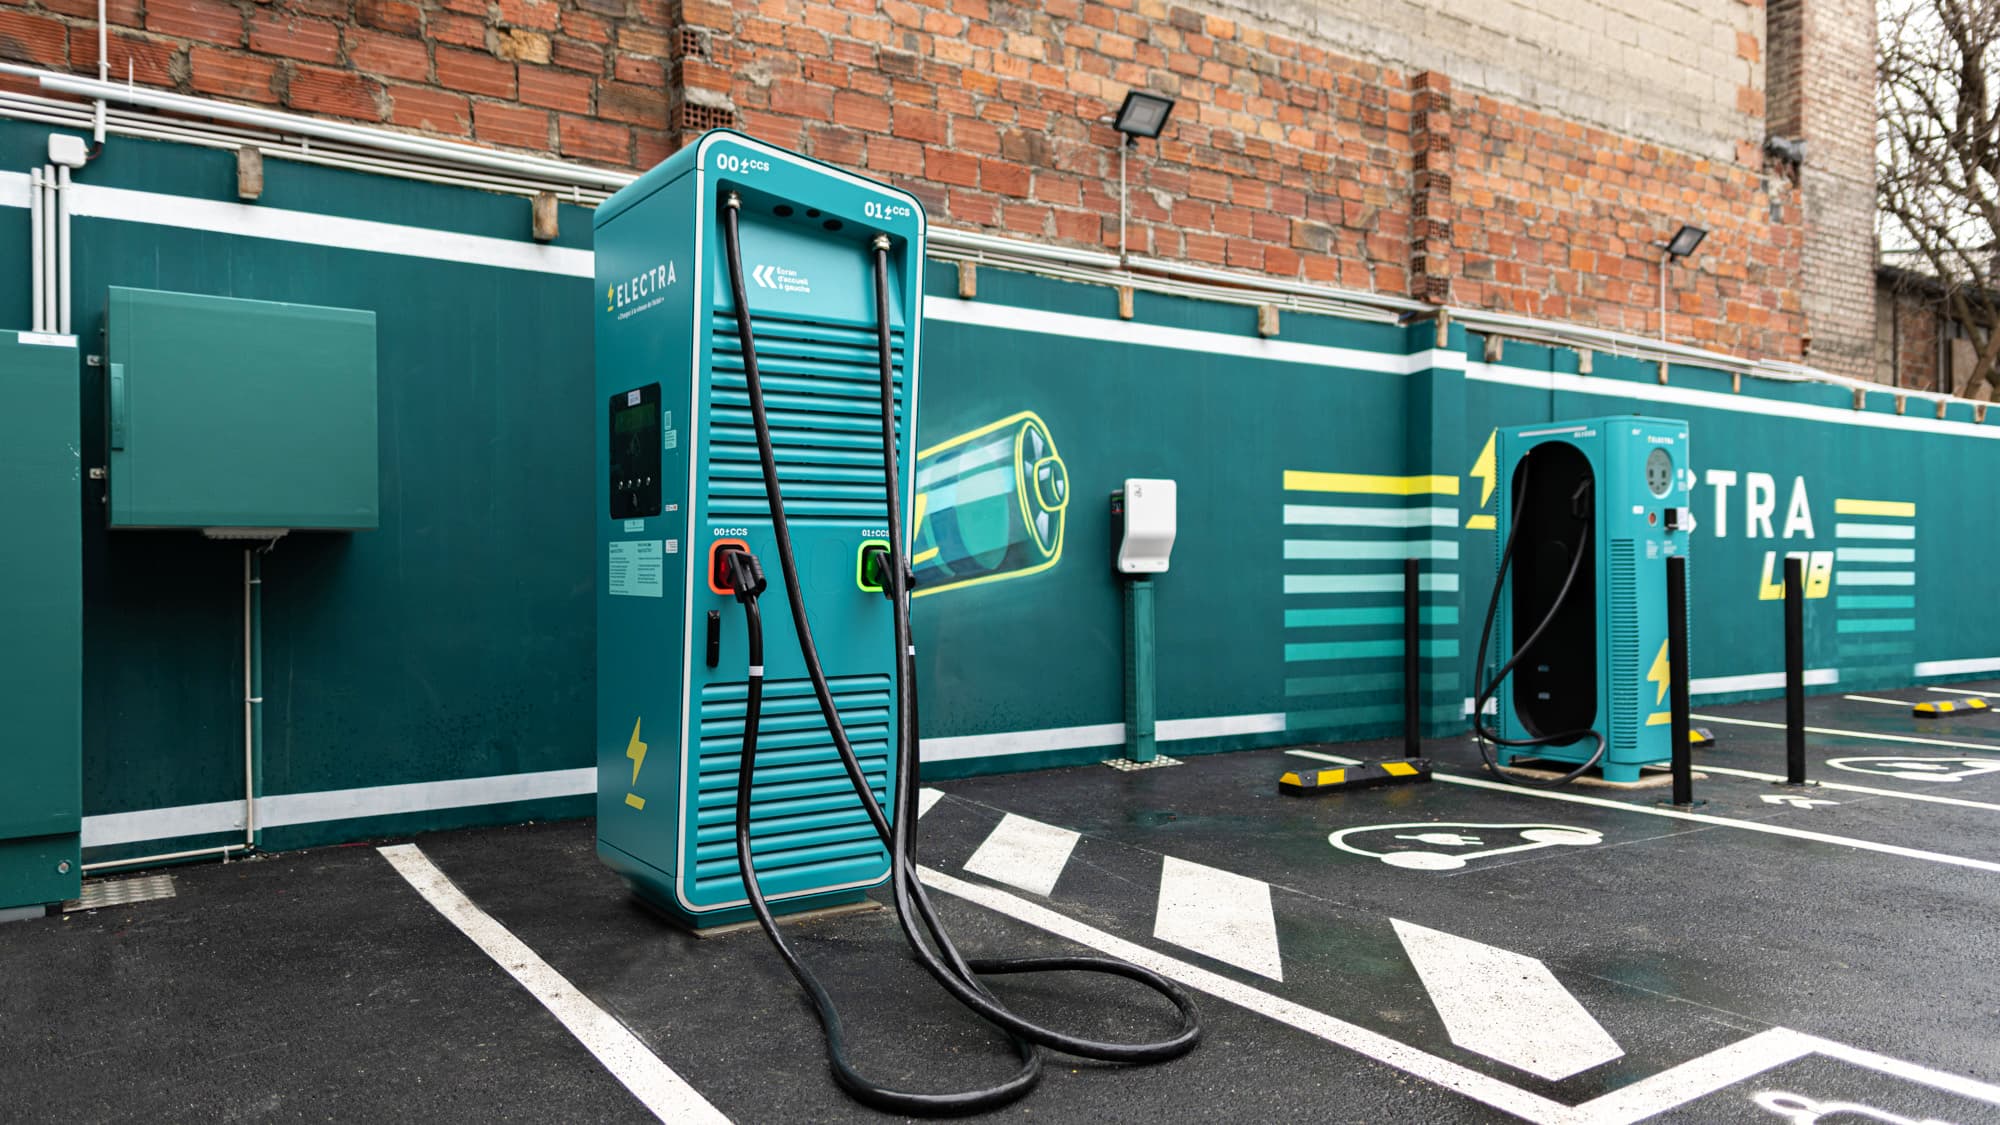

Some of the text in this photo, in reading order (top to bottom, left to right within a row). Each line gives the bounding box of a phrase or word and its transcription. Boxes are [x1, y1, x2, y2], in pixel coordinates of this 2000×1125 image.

[717, 153, 770, 172] 00 CCS
[865, 201, 910, 219] 01 CCS
[617, 259, 677, 308] ELECTRA
[713, 527, 749, 537] 00 CCS
